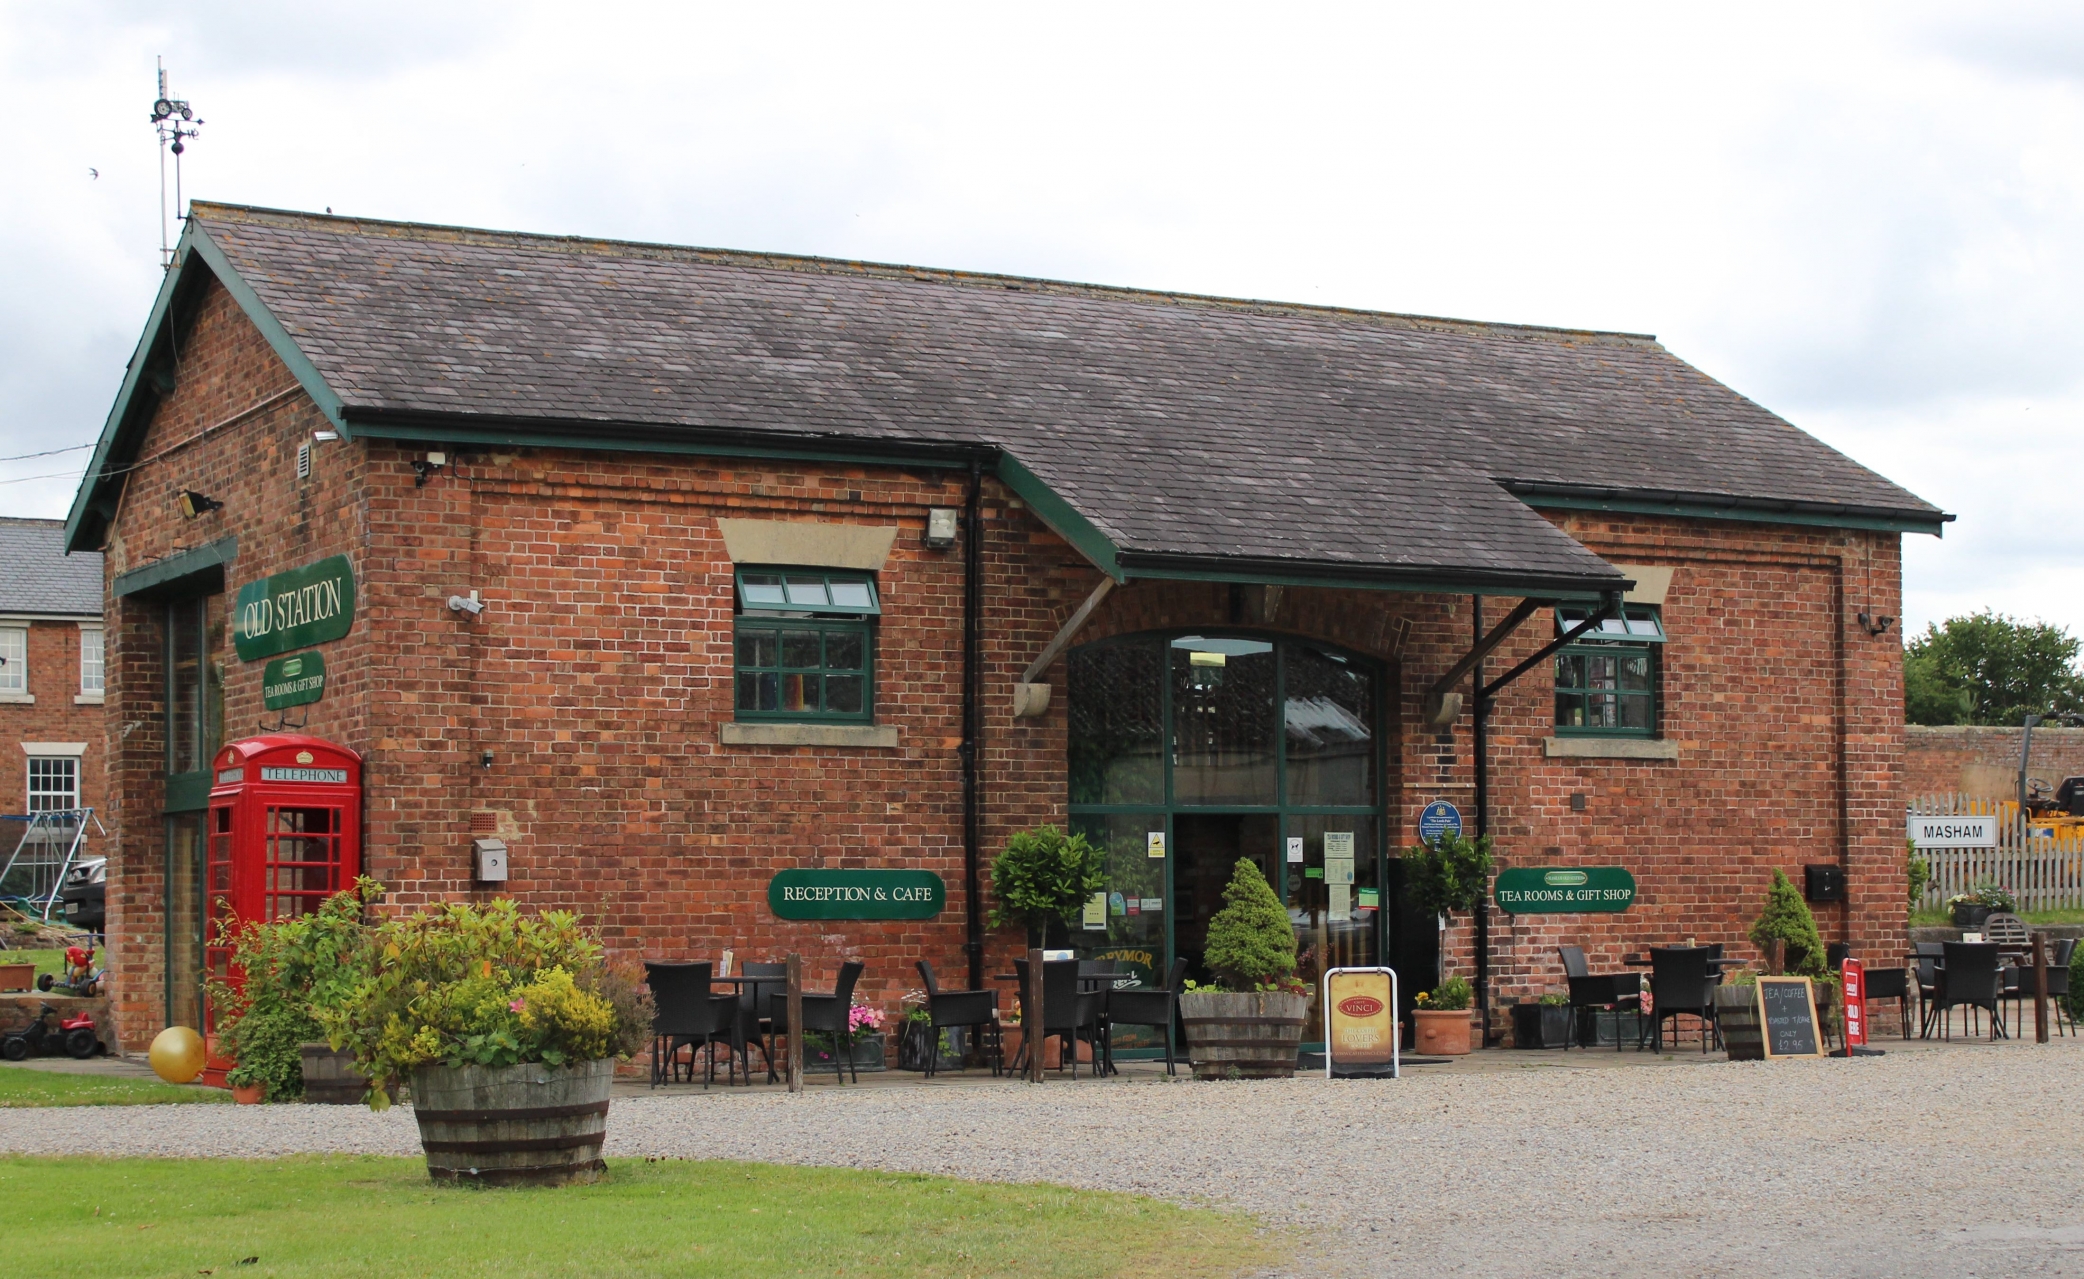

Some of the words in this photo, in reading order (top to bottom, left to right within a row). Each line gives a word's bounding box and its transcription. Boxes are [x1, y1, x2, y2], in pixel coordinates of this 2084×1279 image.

[244, 598, 273, 640] OLD
[276, 577, 341, 632] STATION
[265, 686, 275, 698] TEA
[274, 681, 293, 697] ROOMS
[293, 681, 298, 693] &
[298, 677, 309, 691] GIFT
[309, 675, 323, 690] SHOP
[266, 768, 343, 782] TELEPHONE
[1924, 825, 1983, 839] MASHAM
[783, 886, 870, 901] RECEPTION
[874, 887, 887, 901] &
[893, 887, 932, 901] CAFE
[1500, 890, 1522, 902] TEA
[1524, 890, 1563, 902] ROOMS
[1565, 889, 1574, 901] &
[1576, 889, 1601, 901] GIFT
[1603, 889, 1631, 900] SHOP
[1346, 1004, 1373, 1012] VINCI
[1342, 1034, 1379, 1043] LOVERS
